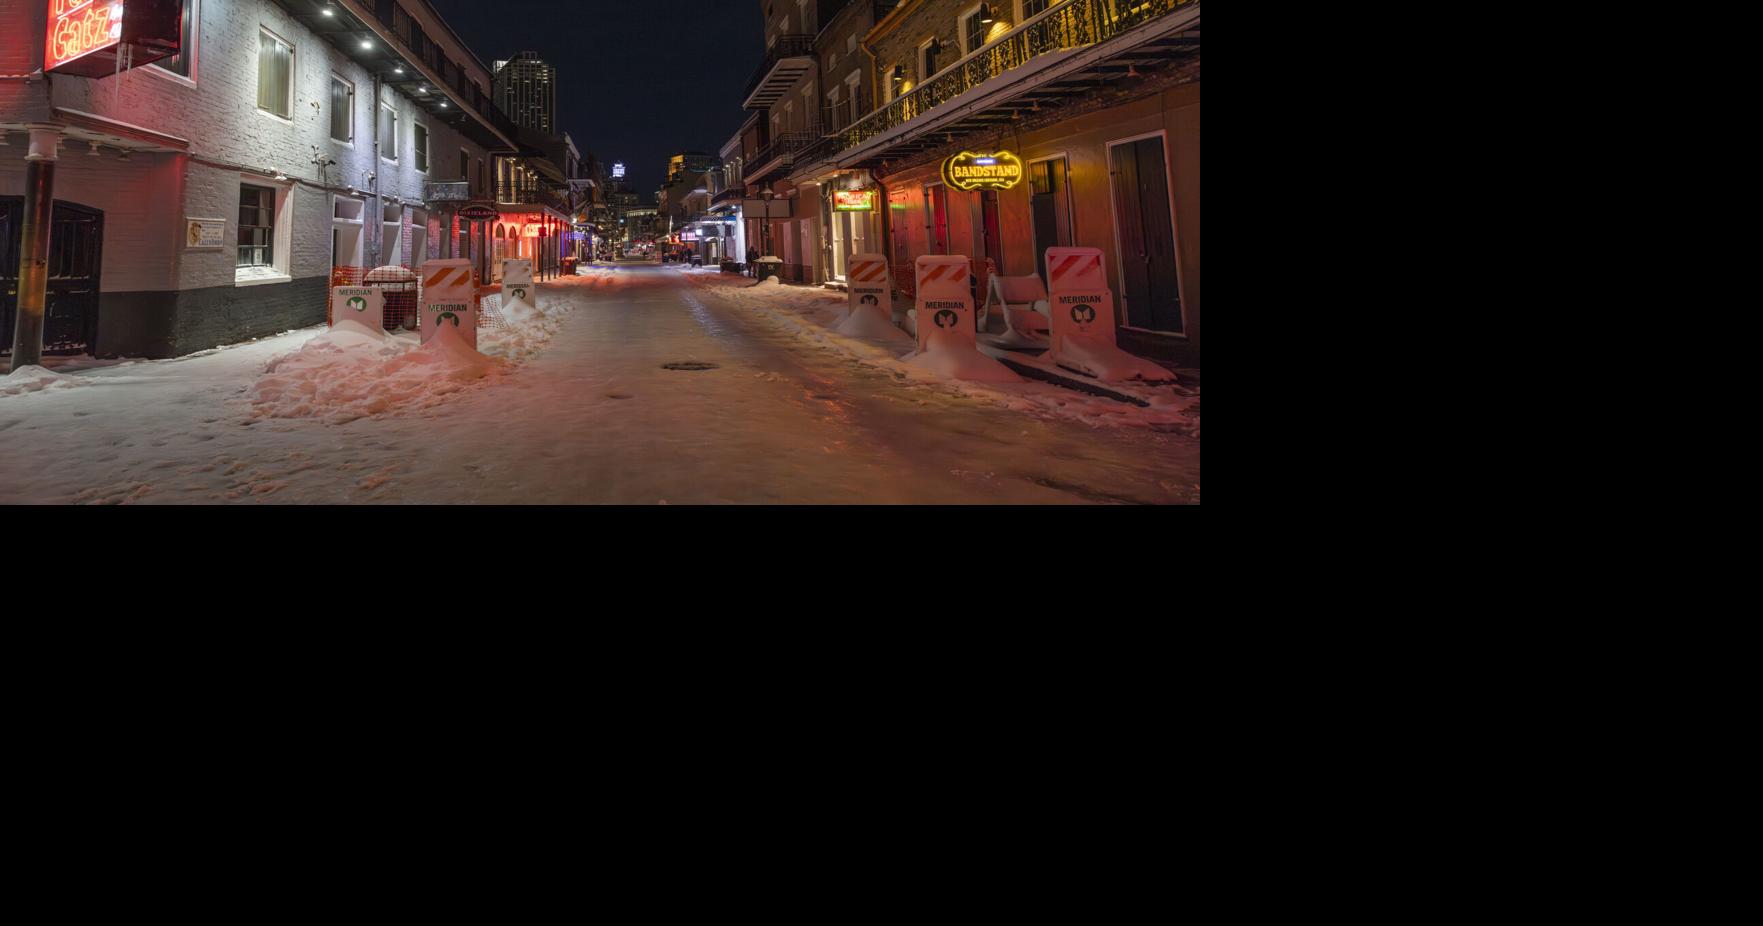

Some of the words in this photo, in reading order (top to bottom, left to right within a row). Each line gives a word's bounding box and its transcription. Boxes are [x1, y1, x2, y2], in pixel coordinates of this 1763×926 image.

[954, 165, 1019, 177] BANDSTAND
[1059, 295, 1101, 304] MERIDIAN
[428, 304, 467, 312] MERIDIAN
[925, 301, 964, 309] MERIDIAN
